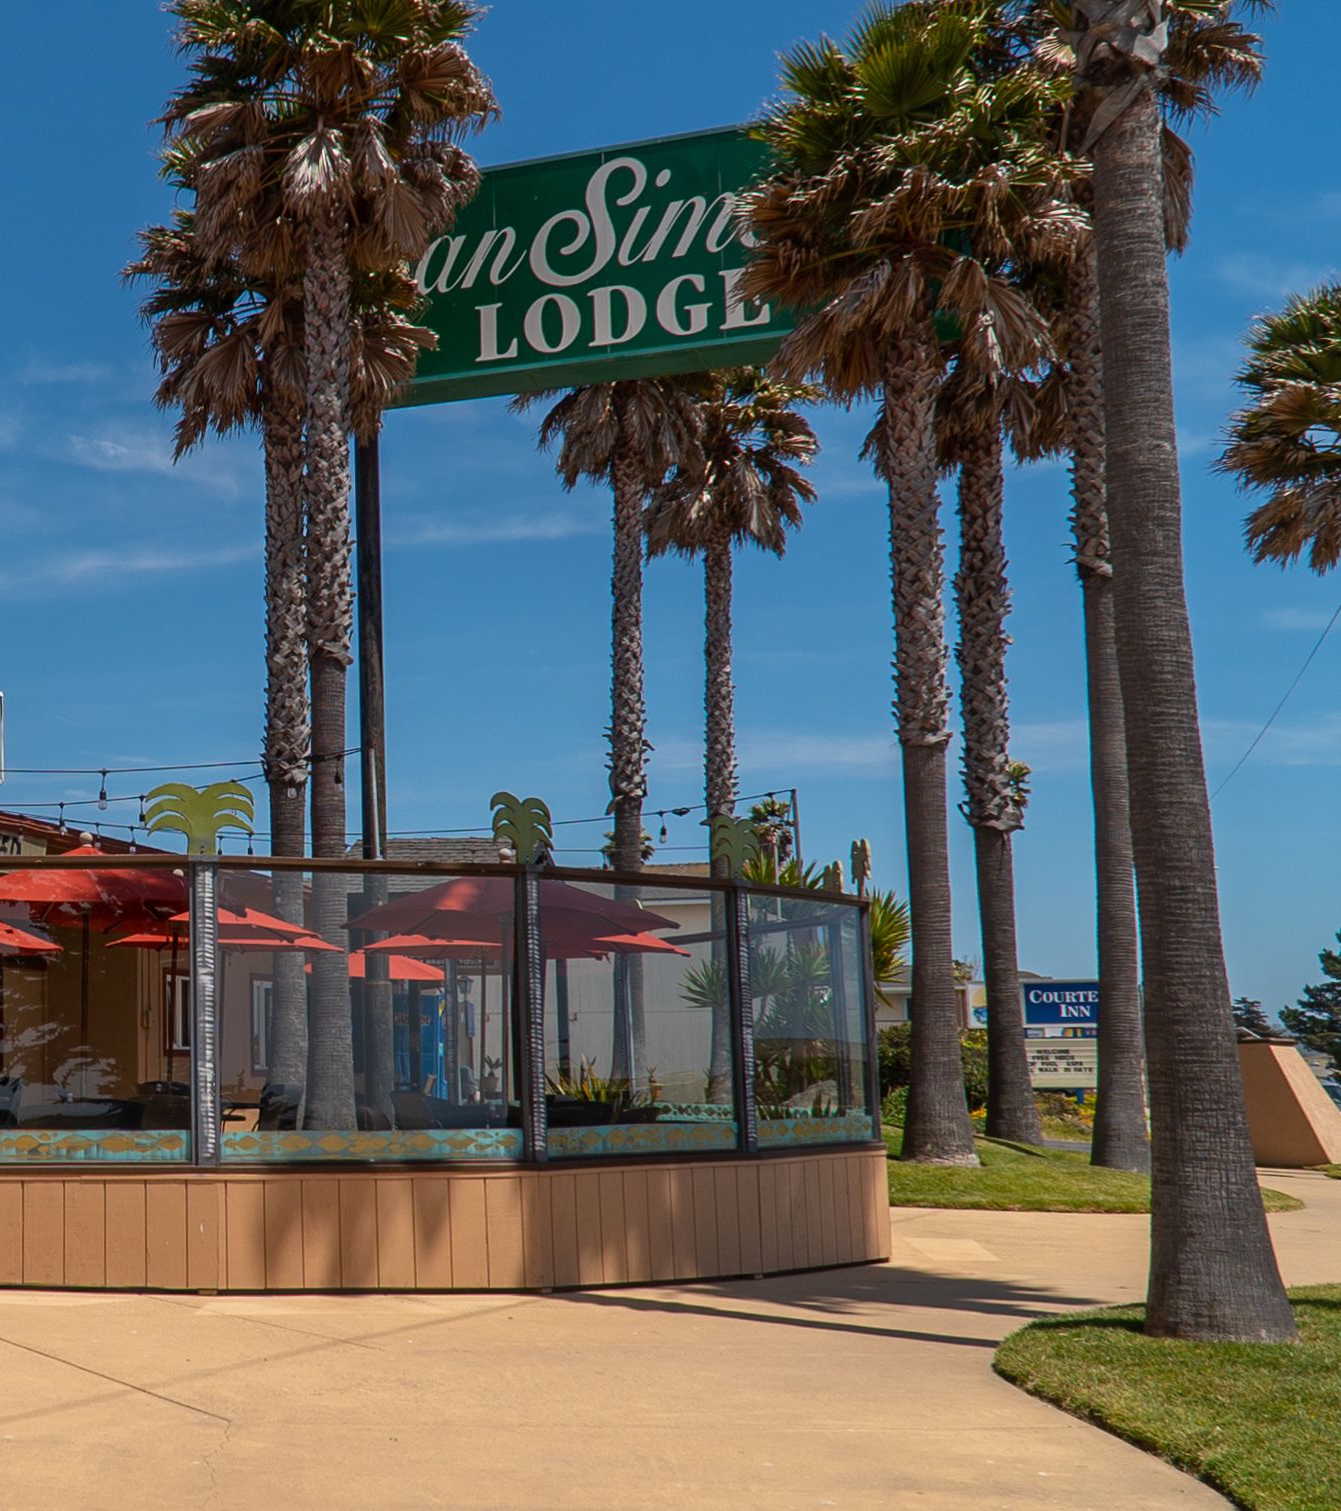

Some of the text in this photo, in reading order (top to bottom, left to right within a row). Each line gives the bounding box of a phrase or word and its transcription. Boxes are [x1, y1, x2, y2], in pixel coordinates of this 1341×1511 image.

[414, 156, 767, 295] an Sim
[474, 268, 770, 362] LODGE
[1028, 989, 1099, 1004] COURTE
[1059, 1004, 1091, 1018] INN
